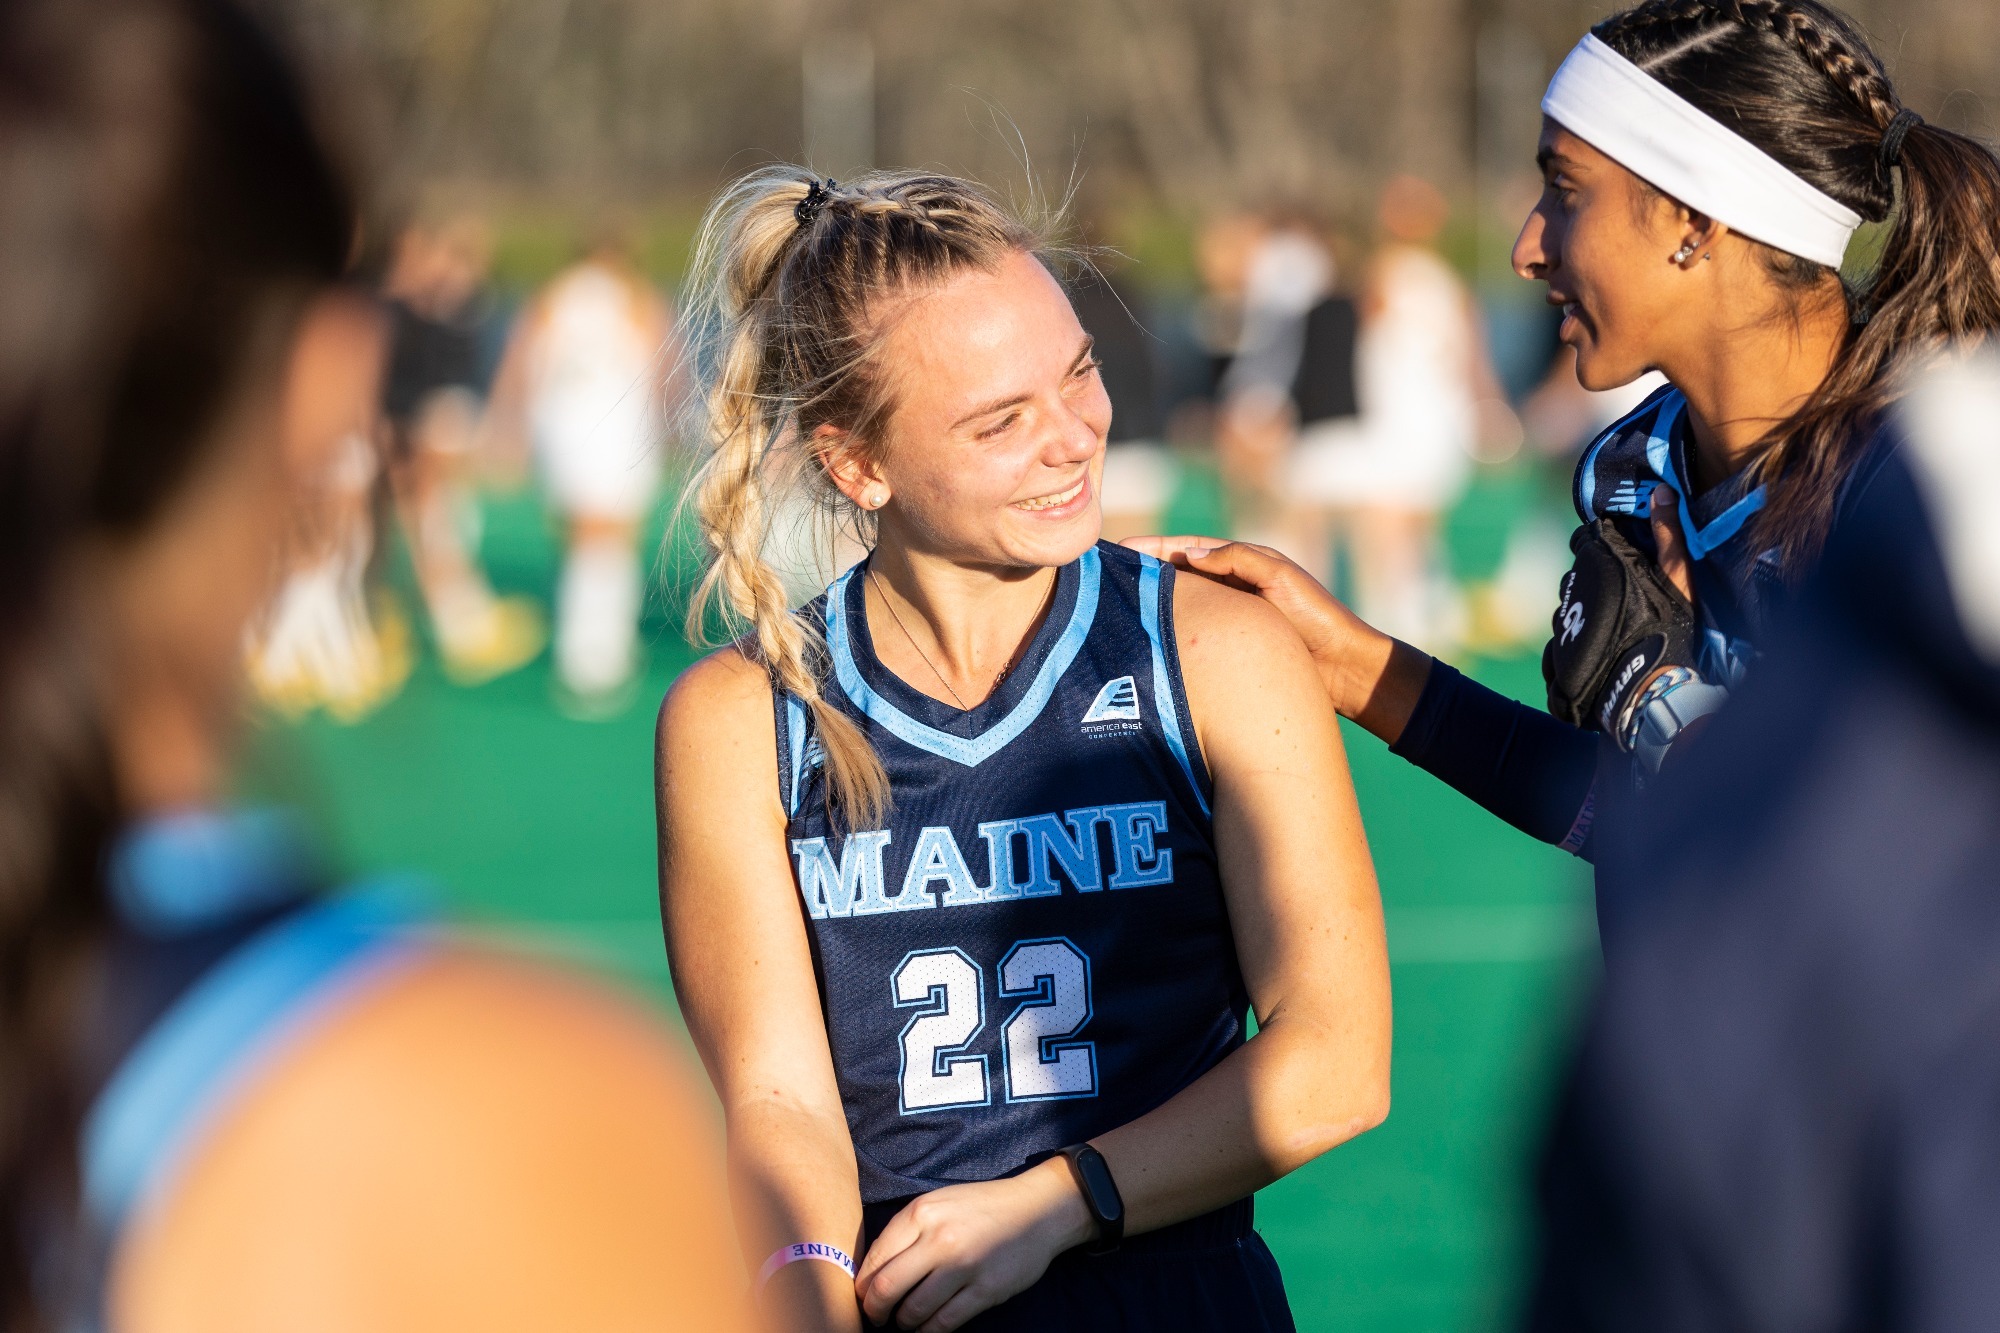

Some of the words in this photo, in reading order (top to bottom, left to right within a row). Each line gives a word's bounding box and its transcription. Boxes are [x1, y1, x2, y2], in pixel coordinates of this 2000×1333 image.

[1081, 723, 1120, 733] america
[1122, 722, 1142, 730] east
[1567, 792, 1594, 847] MAIN
[791, 800, 1174, 920] MAINE
[890, 936, 1098, 1116] 22
[792, 1243, 855, 1273] MAINE
